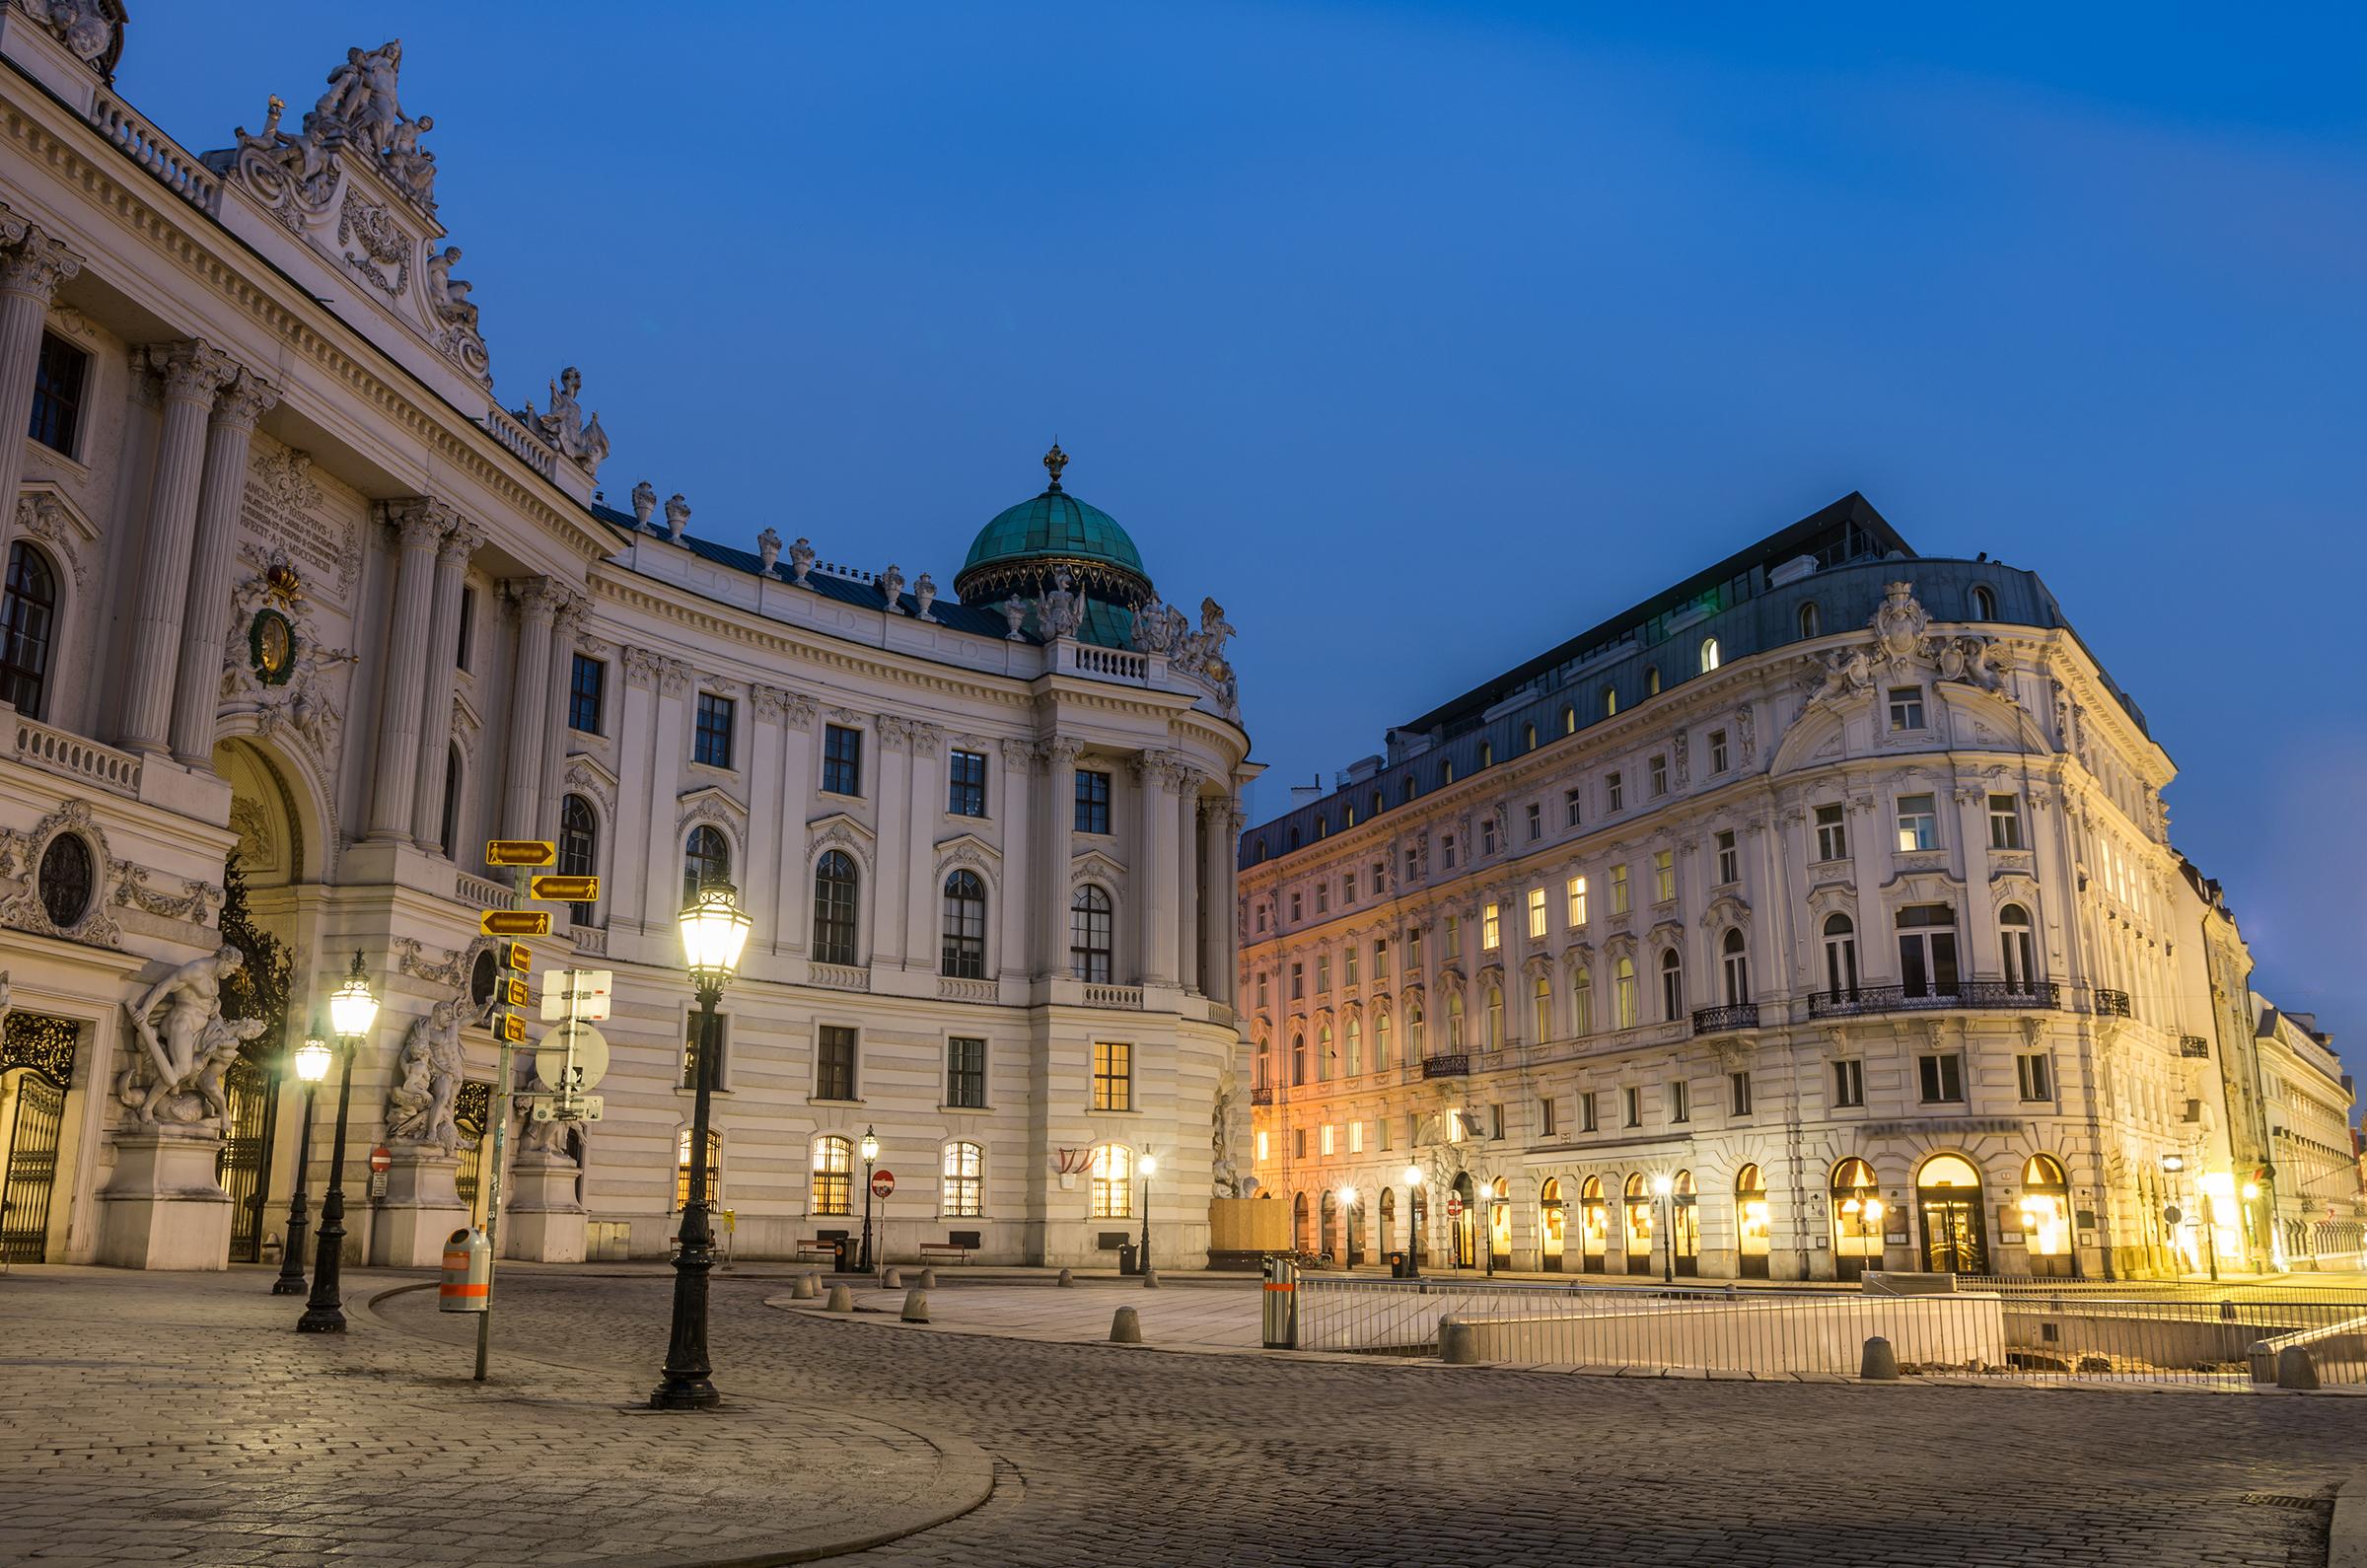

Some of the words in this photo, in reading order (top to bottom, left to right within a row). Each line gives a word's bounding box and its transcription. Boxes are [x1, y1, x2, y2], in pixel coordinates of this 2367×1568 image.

[245, 480, 285, 511] ANCISCVS
[289, 506, 326, 535] IOSEPHVS
[264, 506, 278, 519] OPVS
[240, 515, 269, 538] RFECIT
